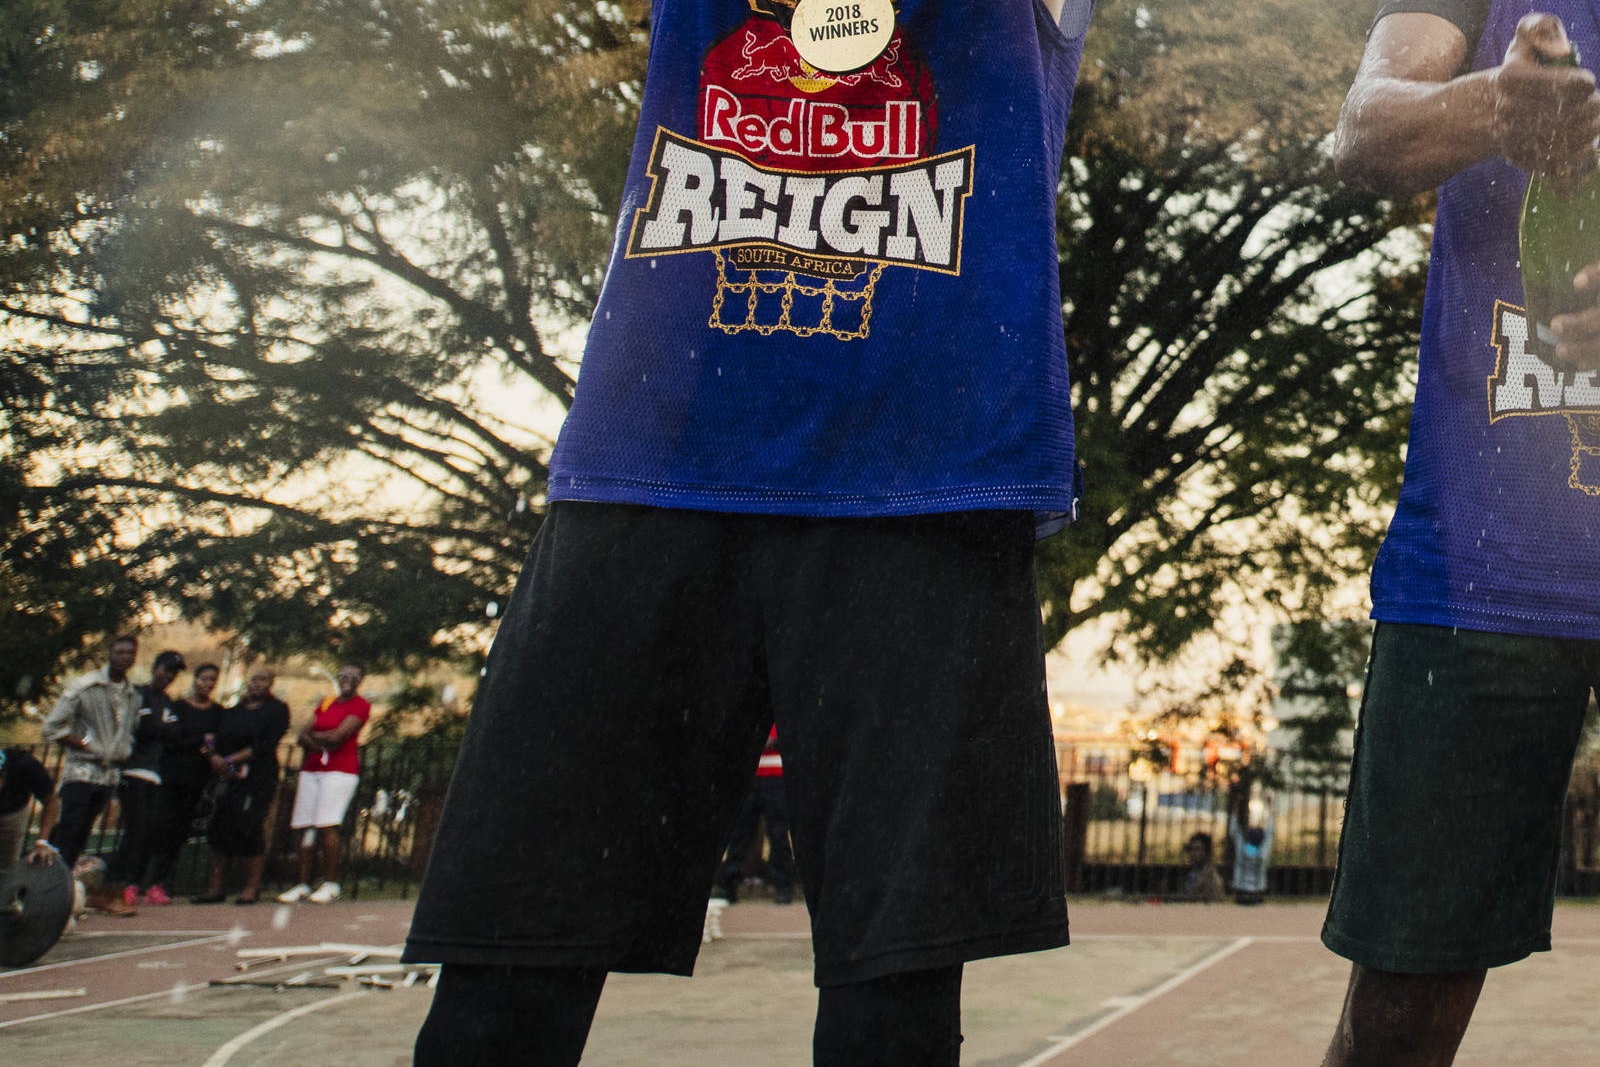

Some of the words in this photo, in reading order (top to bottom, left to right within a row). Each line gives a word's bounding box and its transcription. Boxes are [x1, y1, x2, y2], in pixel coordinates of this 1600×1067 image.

[826, 4, 861, 24] 2018
[810, 19, 879, 41] WINNERS
[640, 141, 964, 265] REIGN
[737, 248, 788, 264] SOUTH
[790, 256, 855, 275] AFRICA
